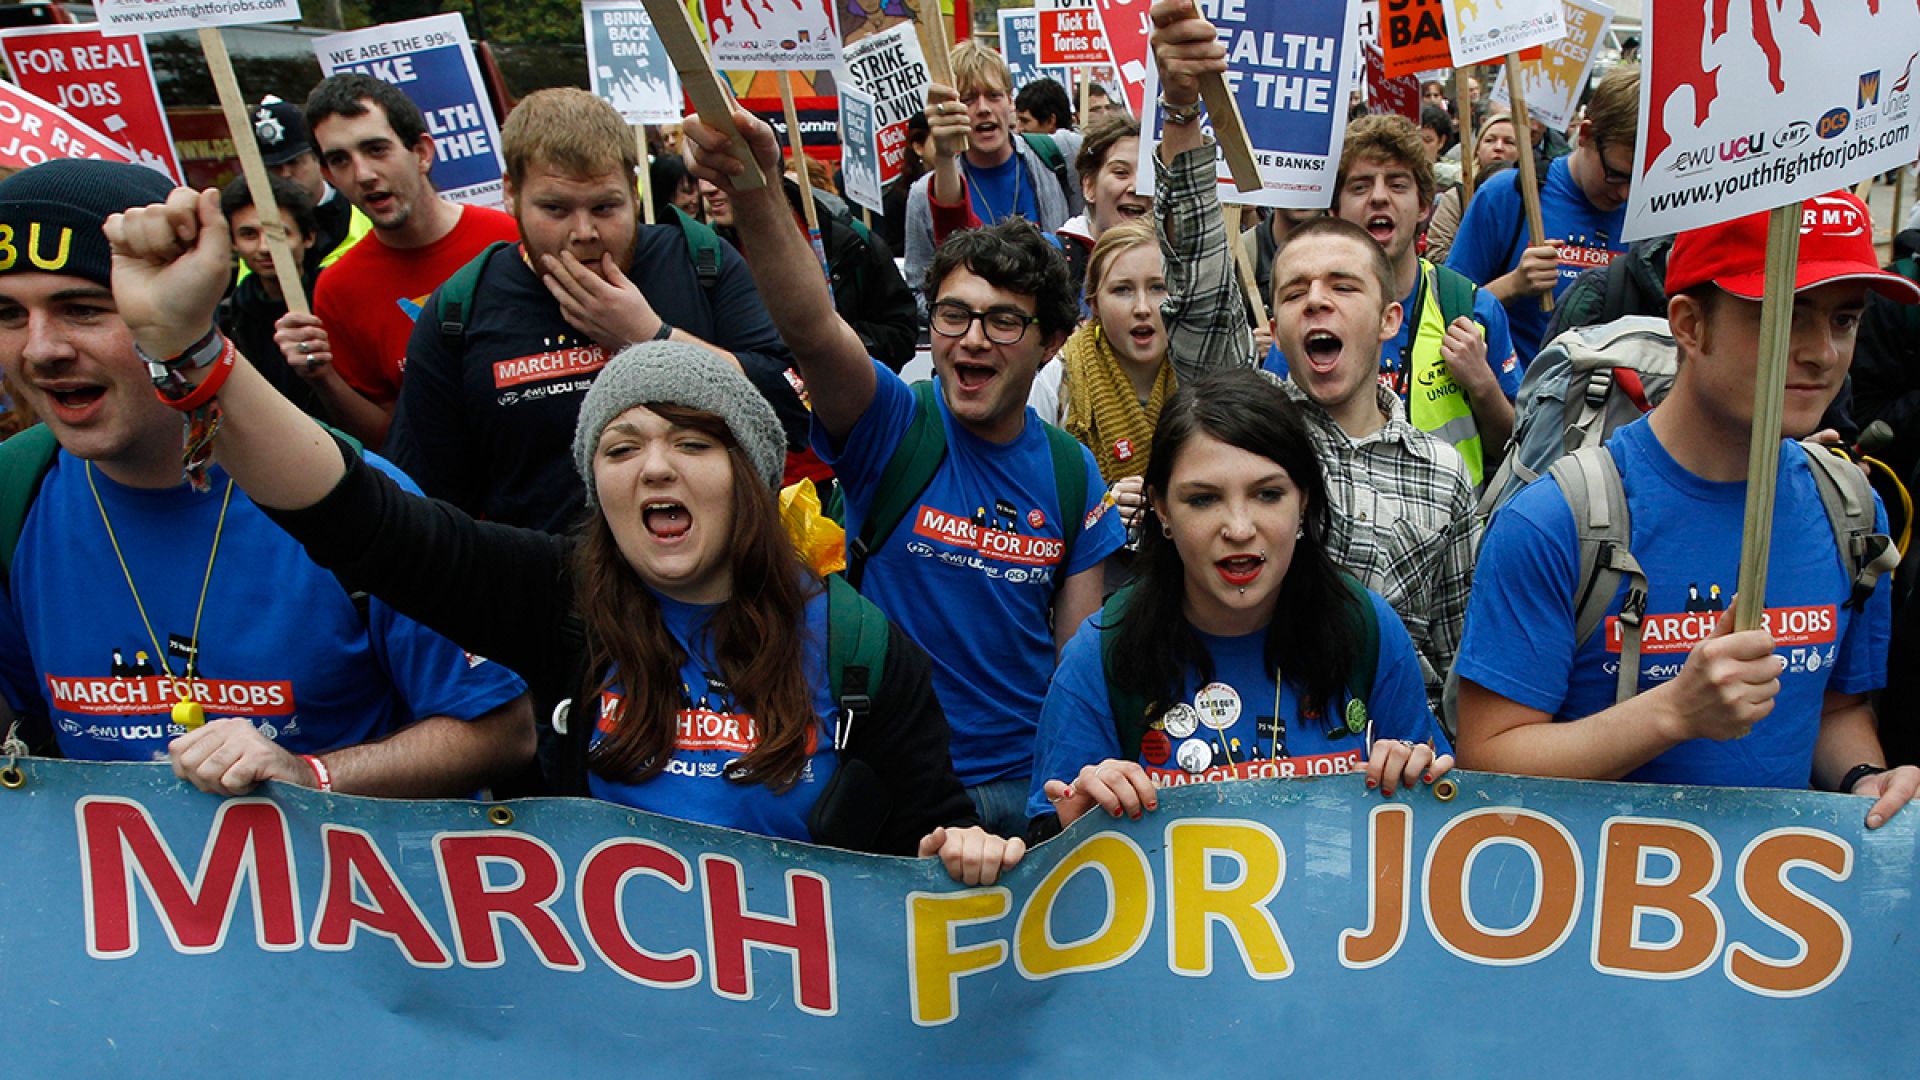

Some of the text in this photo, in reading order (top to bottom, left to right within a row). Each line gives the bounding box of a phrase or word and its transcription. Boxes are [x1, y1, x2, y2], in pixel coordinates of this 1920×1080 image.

[110, 0, 287, 23] www.youthfightforjobs.com
[603, 11, 651, 26] BRING
[1013, 19, 1035, 30] BRI
[1057, 11, 1100, 31] Kick th
[1567, 5, 1587, 26] VE
[608, 26, 651, 41] BACK
[1018, 31, 1035, 43] BA
[1052, 32, 1089, 51] Tories
[1092, 35, 1108, 50] ou
[1390, 10, 1450, 48] BA
[14, 43, 140, 75] FOR REAL
[329, 32, 456, 64] WE ARE THE 99%
[612, 42, 649, 56] EMA
[719, 52, 836, 62] www.youthfightforjobs.com
[1216, 27, 1335, 72] EALTH
[850, 43, 909, 86] STRIKE
[57, 81, 121, 109] JOBS
[860, 62, 928, 104] GETHER
[1253, 72, 1332, 114] THE
[888, 89, 924, 121] WIN
[424, 104, 480, 135] LTH
[1780, 127, 1806, 143] RMT
[1820, 112, 1848, 139] pcs
[50, 127, 101, 159] RE
[434, 130, 491, 162] THE
[880, 126, 906, 148] Kick
[0, 136, 57, 167] JO
[881, 144, 905, 167] Tori
[1275, 156, 1326, 171] BANKS!
[1650, 125, 1909, 214] www.youthfightforjobs.com
[1803, 210, 1857, 226] RMT
[1555, 247, 1608, 265] RCH FOR
[499, 354, 564, 379] MARCH
[569, 348, 603, 366] FOR
[1429, 368, 1446, 380] RM
[1427, 384, 1457, 401] UNIO
[923, 511, 977, 539] MARC
[982, 532, 1020, 554] FOR
[1025, 540, 1063, 558] JOBS
[1778, 610, 1832, 634] JOBS
[51, 679, 285, 706] MARCH FOR JOBS
[696, 714, 740, 740] FOR
[1247, 763, 1295, 780] FOR
[75, 794, 1853, 1027] MARCH FOR JOBS
